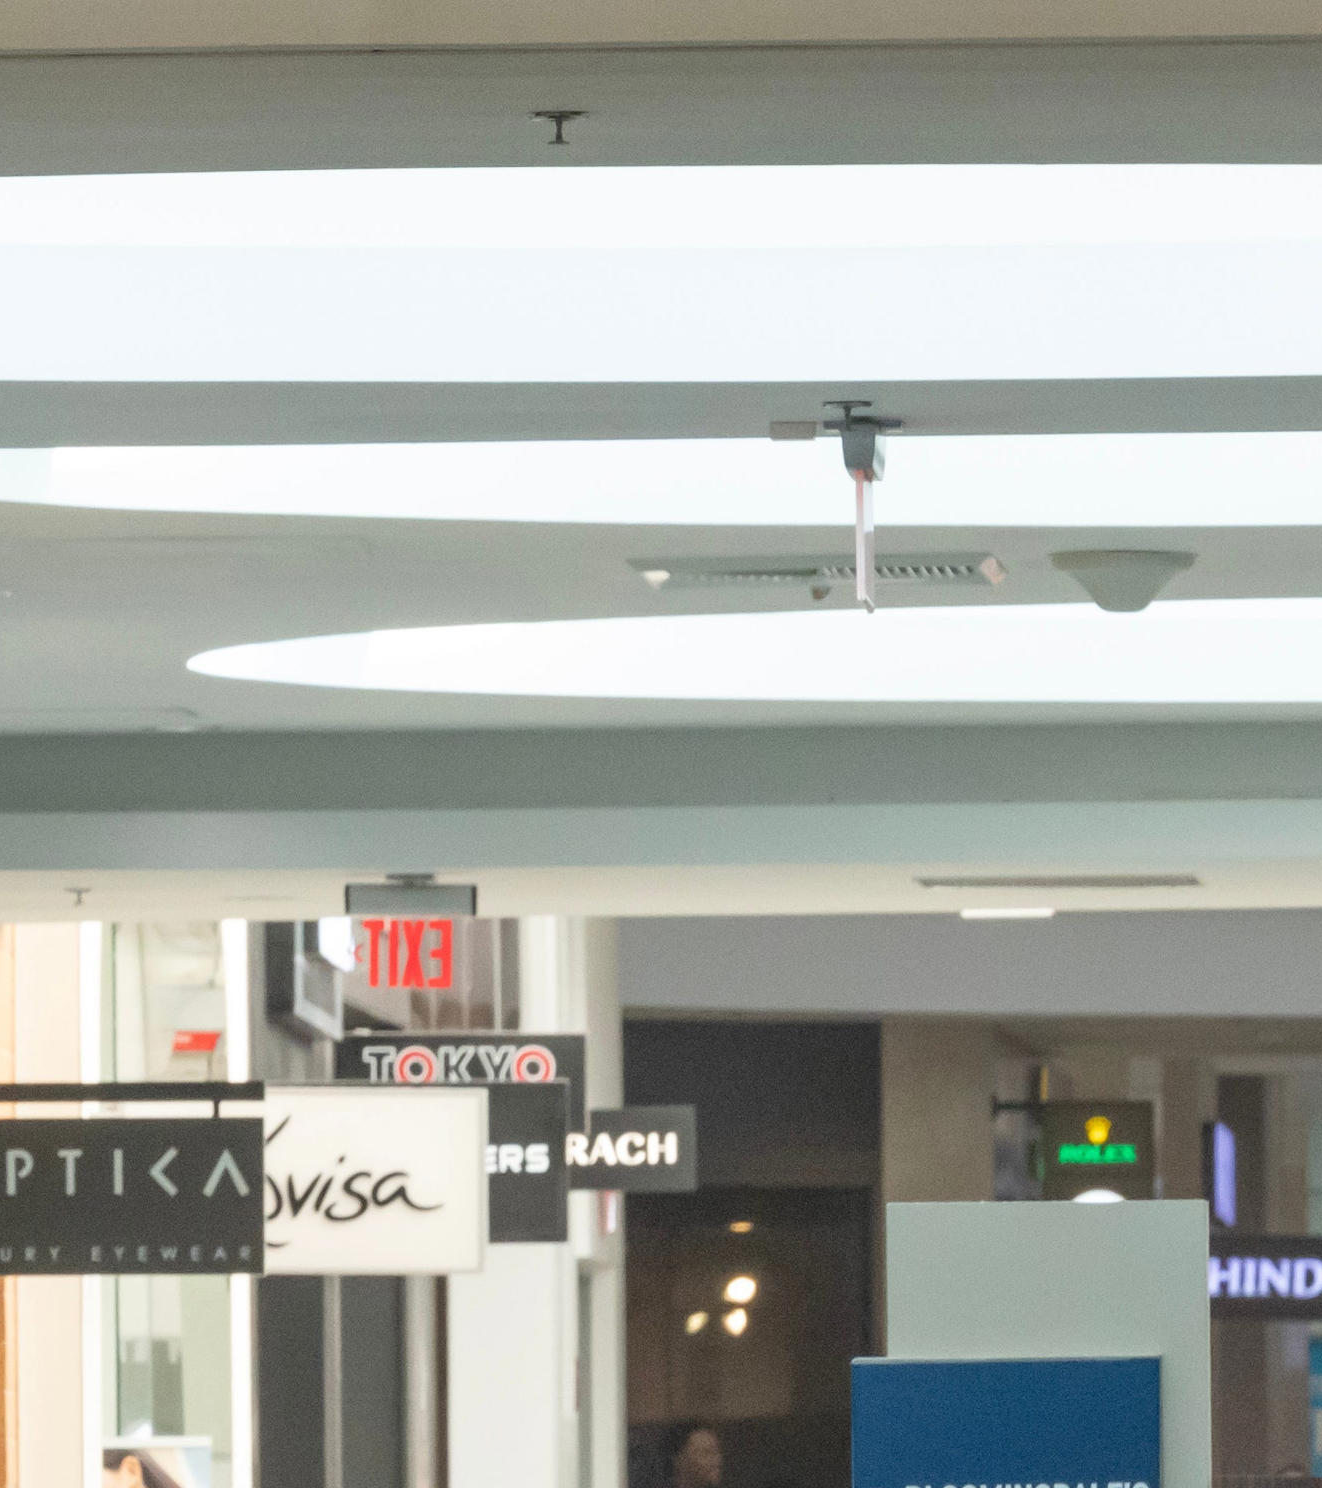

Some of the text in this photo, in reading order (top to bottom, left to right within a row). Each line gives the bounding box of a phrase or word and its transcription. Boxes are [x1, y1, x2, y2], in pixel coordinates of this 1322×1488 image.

[361, 1045, 556, 1083] TOKYO
[266, 1115, 444, 1248] visa
[90, 1245, 253, 1264] EYEWEAR
